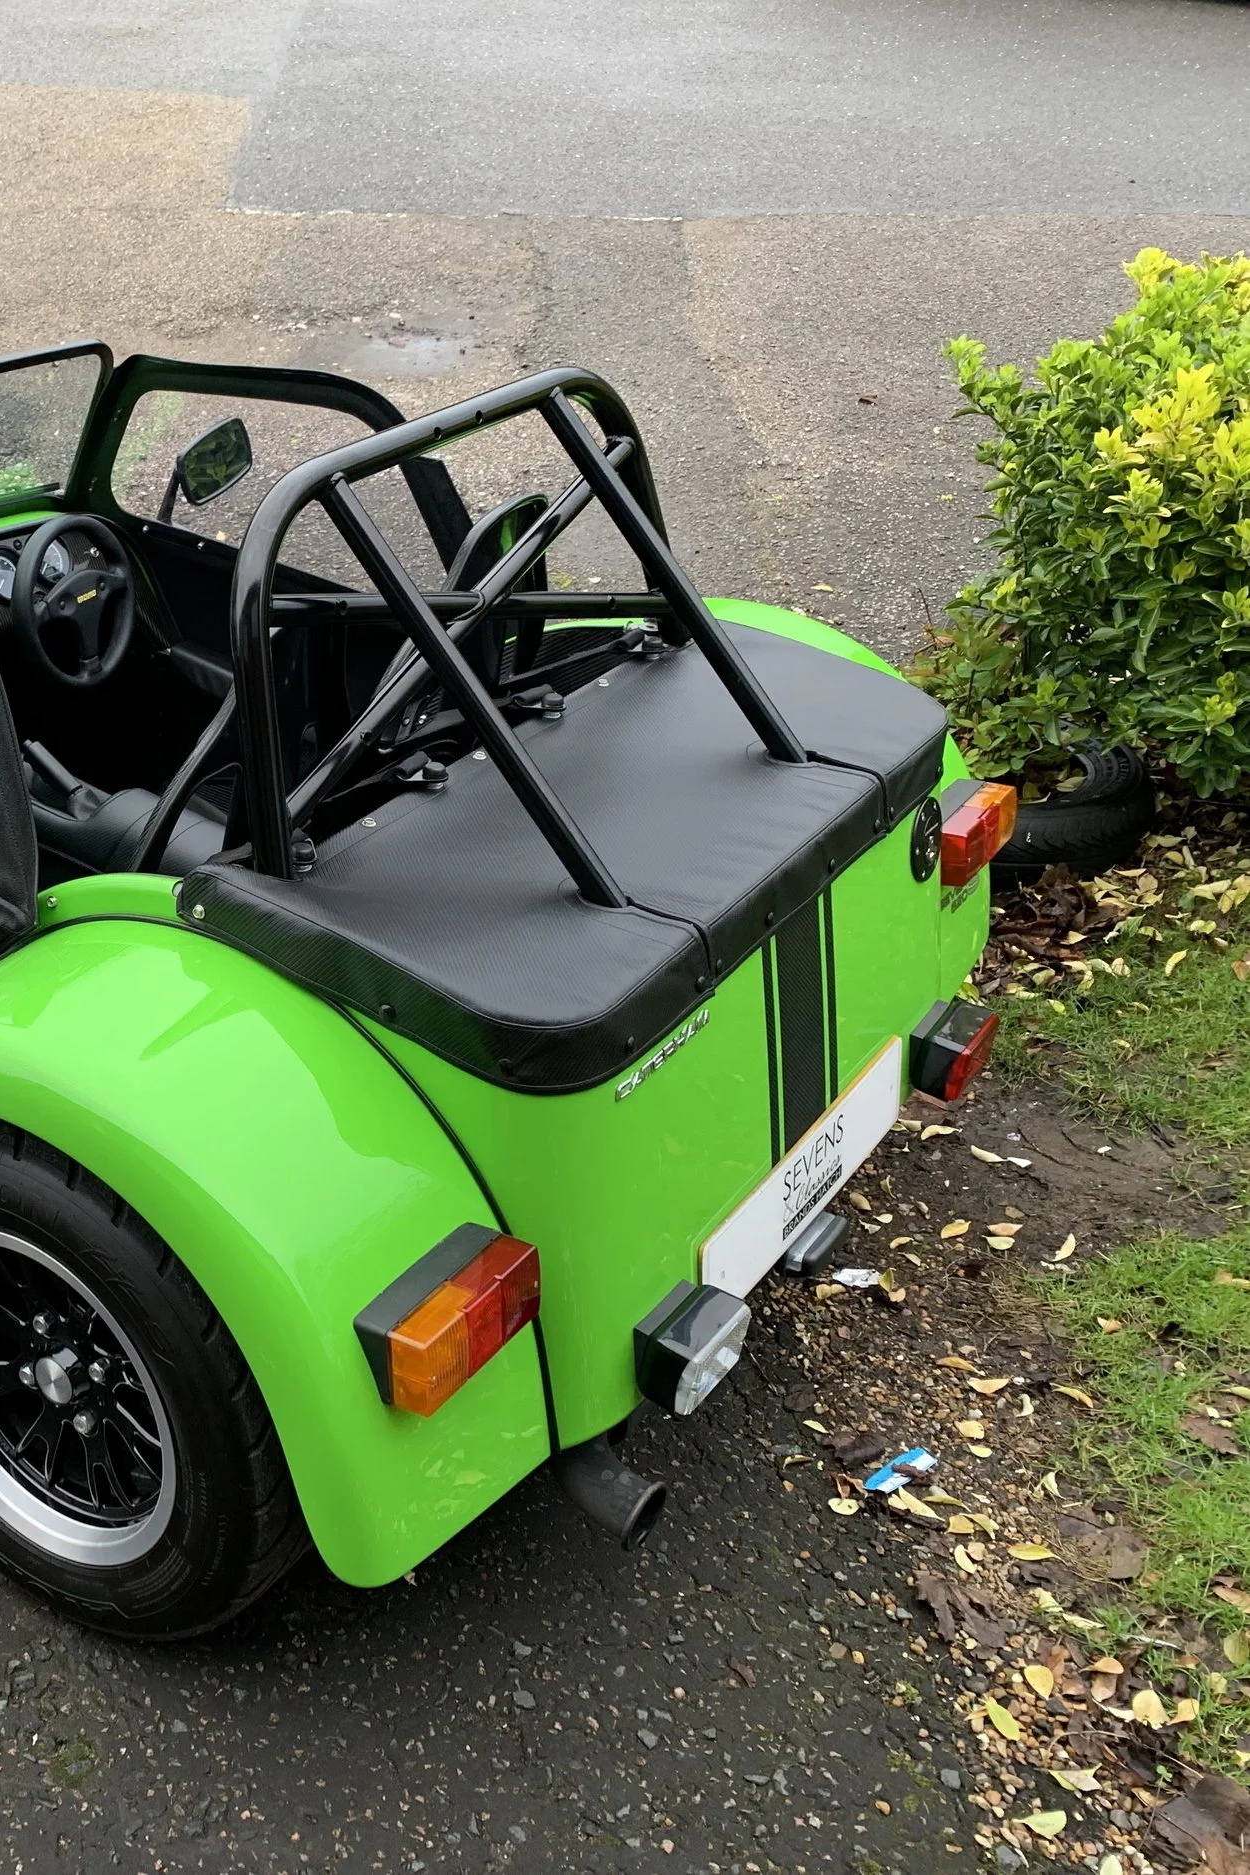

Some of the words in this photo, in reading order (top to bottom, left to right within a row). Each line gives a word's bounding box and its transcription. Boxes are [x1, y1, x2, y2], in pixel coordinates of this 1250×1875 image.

[783, 1114, 844, 1201] SEVENS
[783, 1195, 815, 1240] BRANDS
[815, 1165, 842, 1204] HATCH
